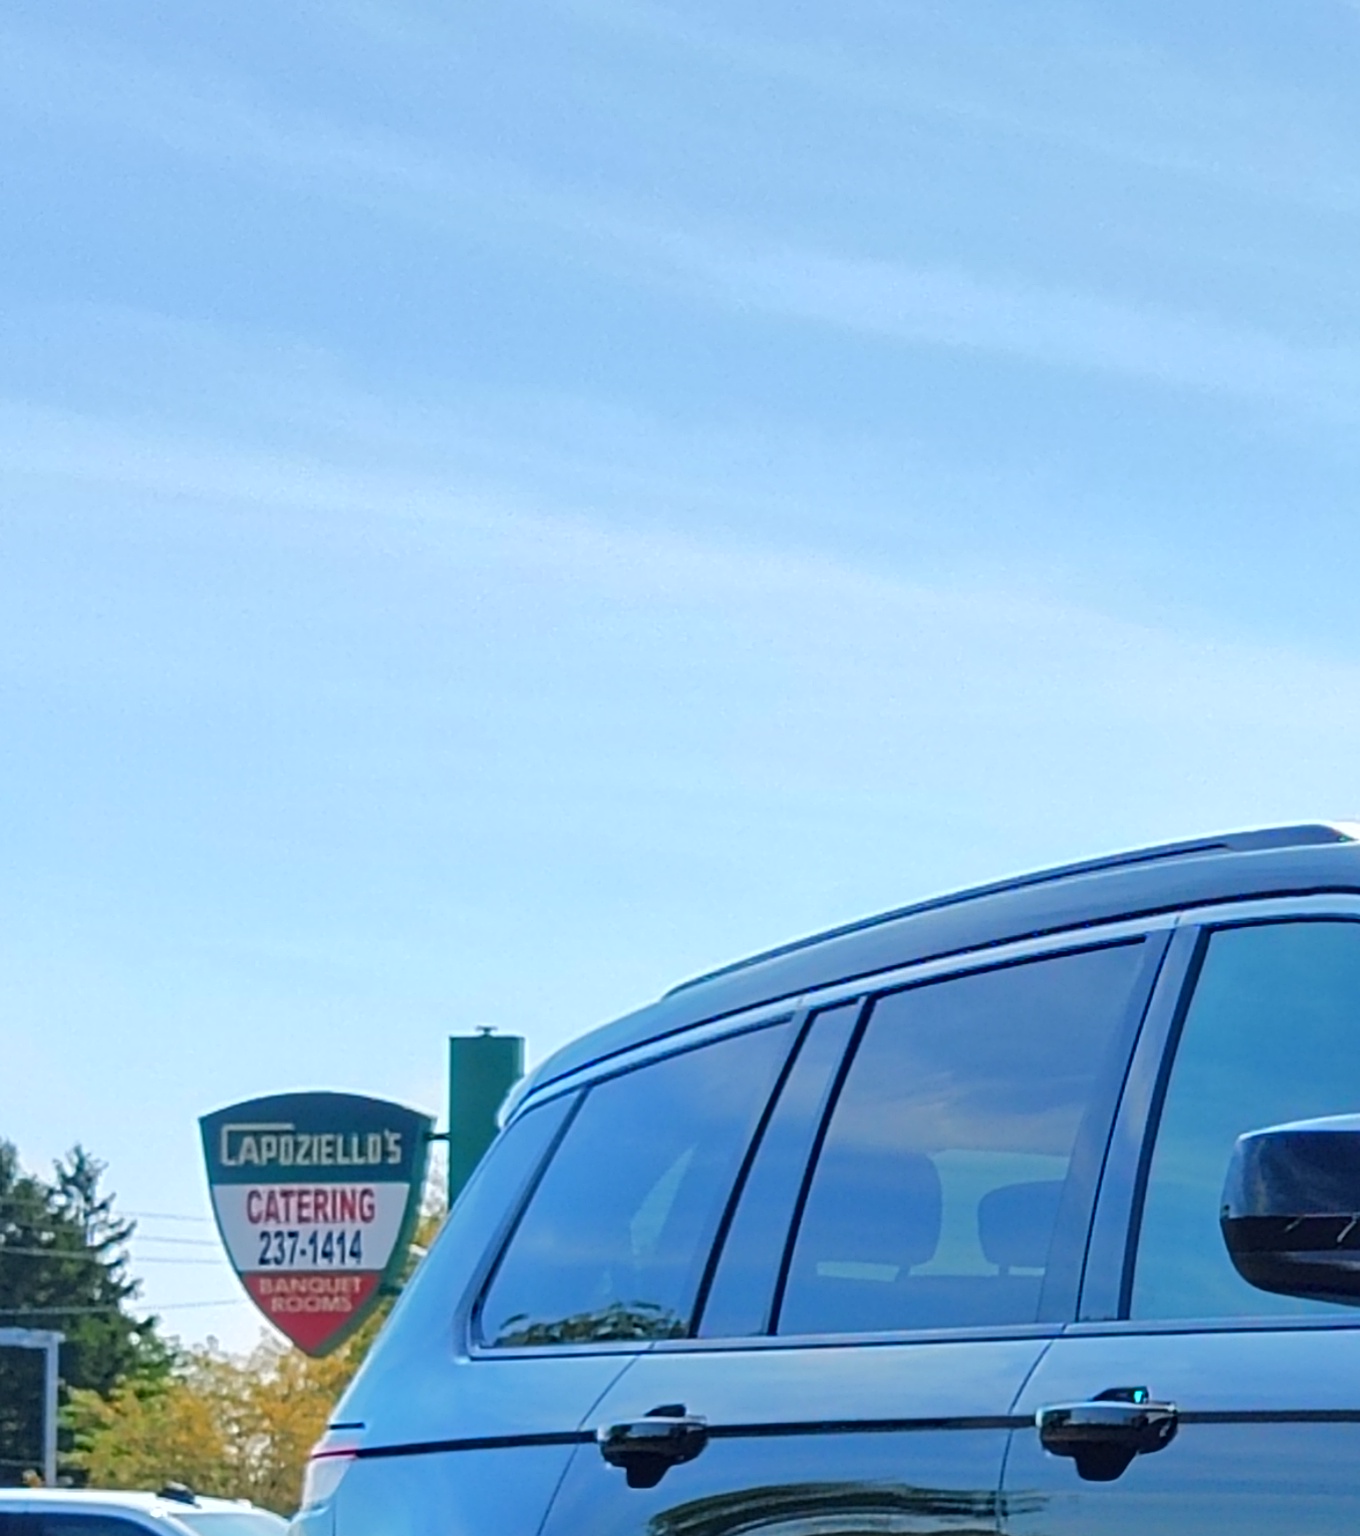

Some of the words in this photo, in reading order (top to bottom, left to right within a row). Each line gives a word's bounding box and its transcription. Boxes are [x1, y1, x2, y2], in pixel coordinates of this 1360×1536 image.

[221, 1123, 402, 1166] CAPOZIELLO'S
[247, 1188, 375, 1224] CATERING
[258, 1229, 363, 1265] 237-1414
[259, 1275, 362, 1294] BANQUET
[270, 1296, 353, 1313] ROOMS
